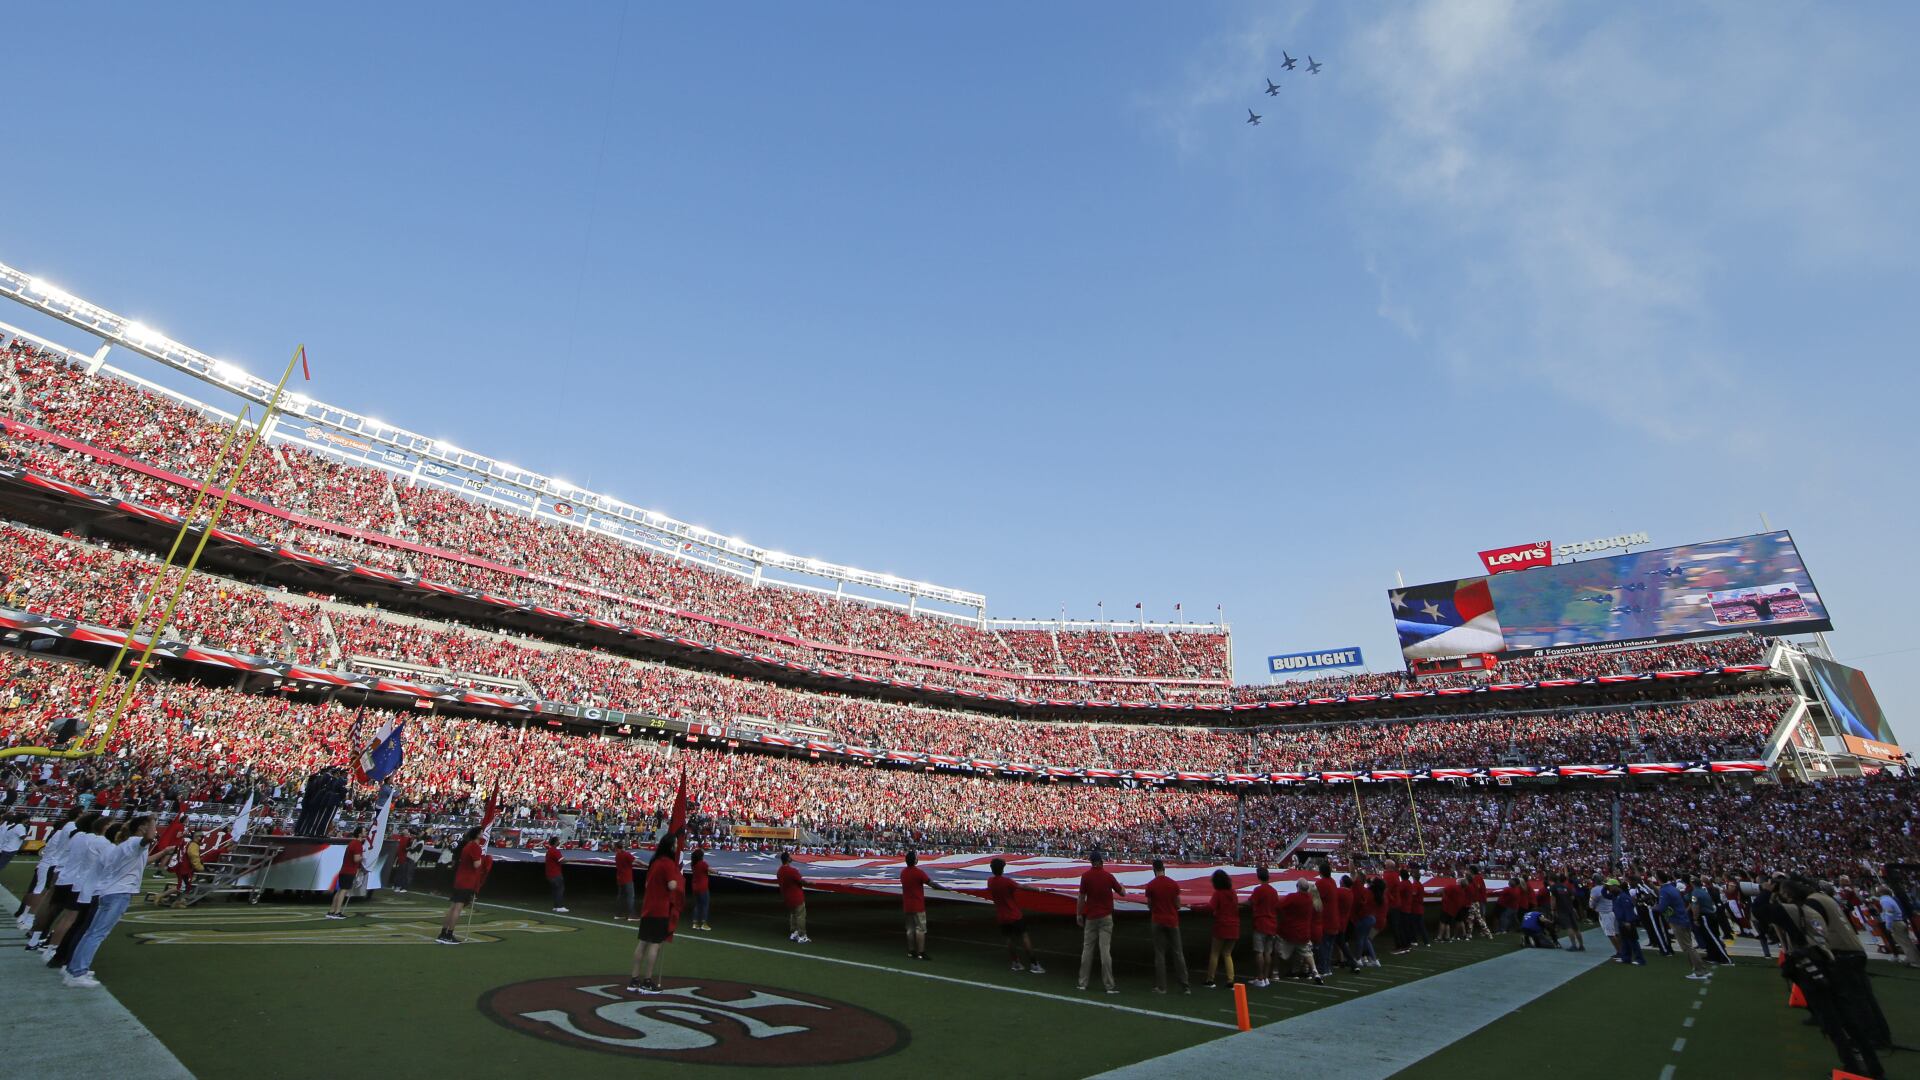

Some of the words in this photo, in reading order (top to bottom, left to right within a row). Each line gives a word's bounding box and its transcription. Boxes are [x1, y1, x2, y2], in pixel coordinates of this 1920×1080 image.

[427, 464, 448, 476] SAP
[466, 478, 484, 490] nrg
[1558, 531, 1650, 556] STADIUM
[1546, 646, 1581, 656] Foxconn
[1582, 641, 1622, 652] Industrial
[1623, 638, 1658, 648] Internet
[650, 718, 666, 728] 2:57
